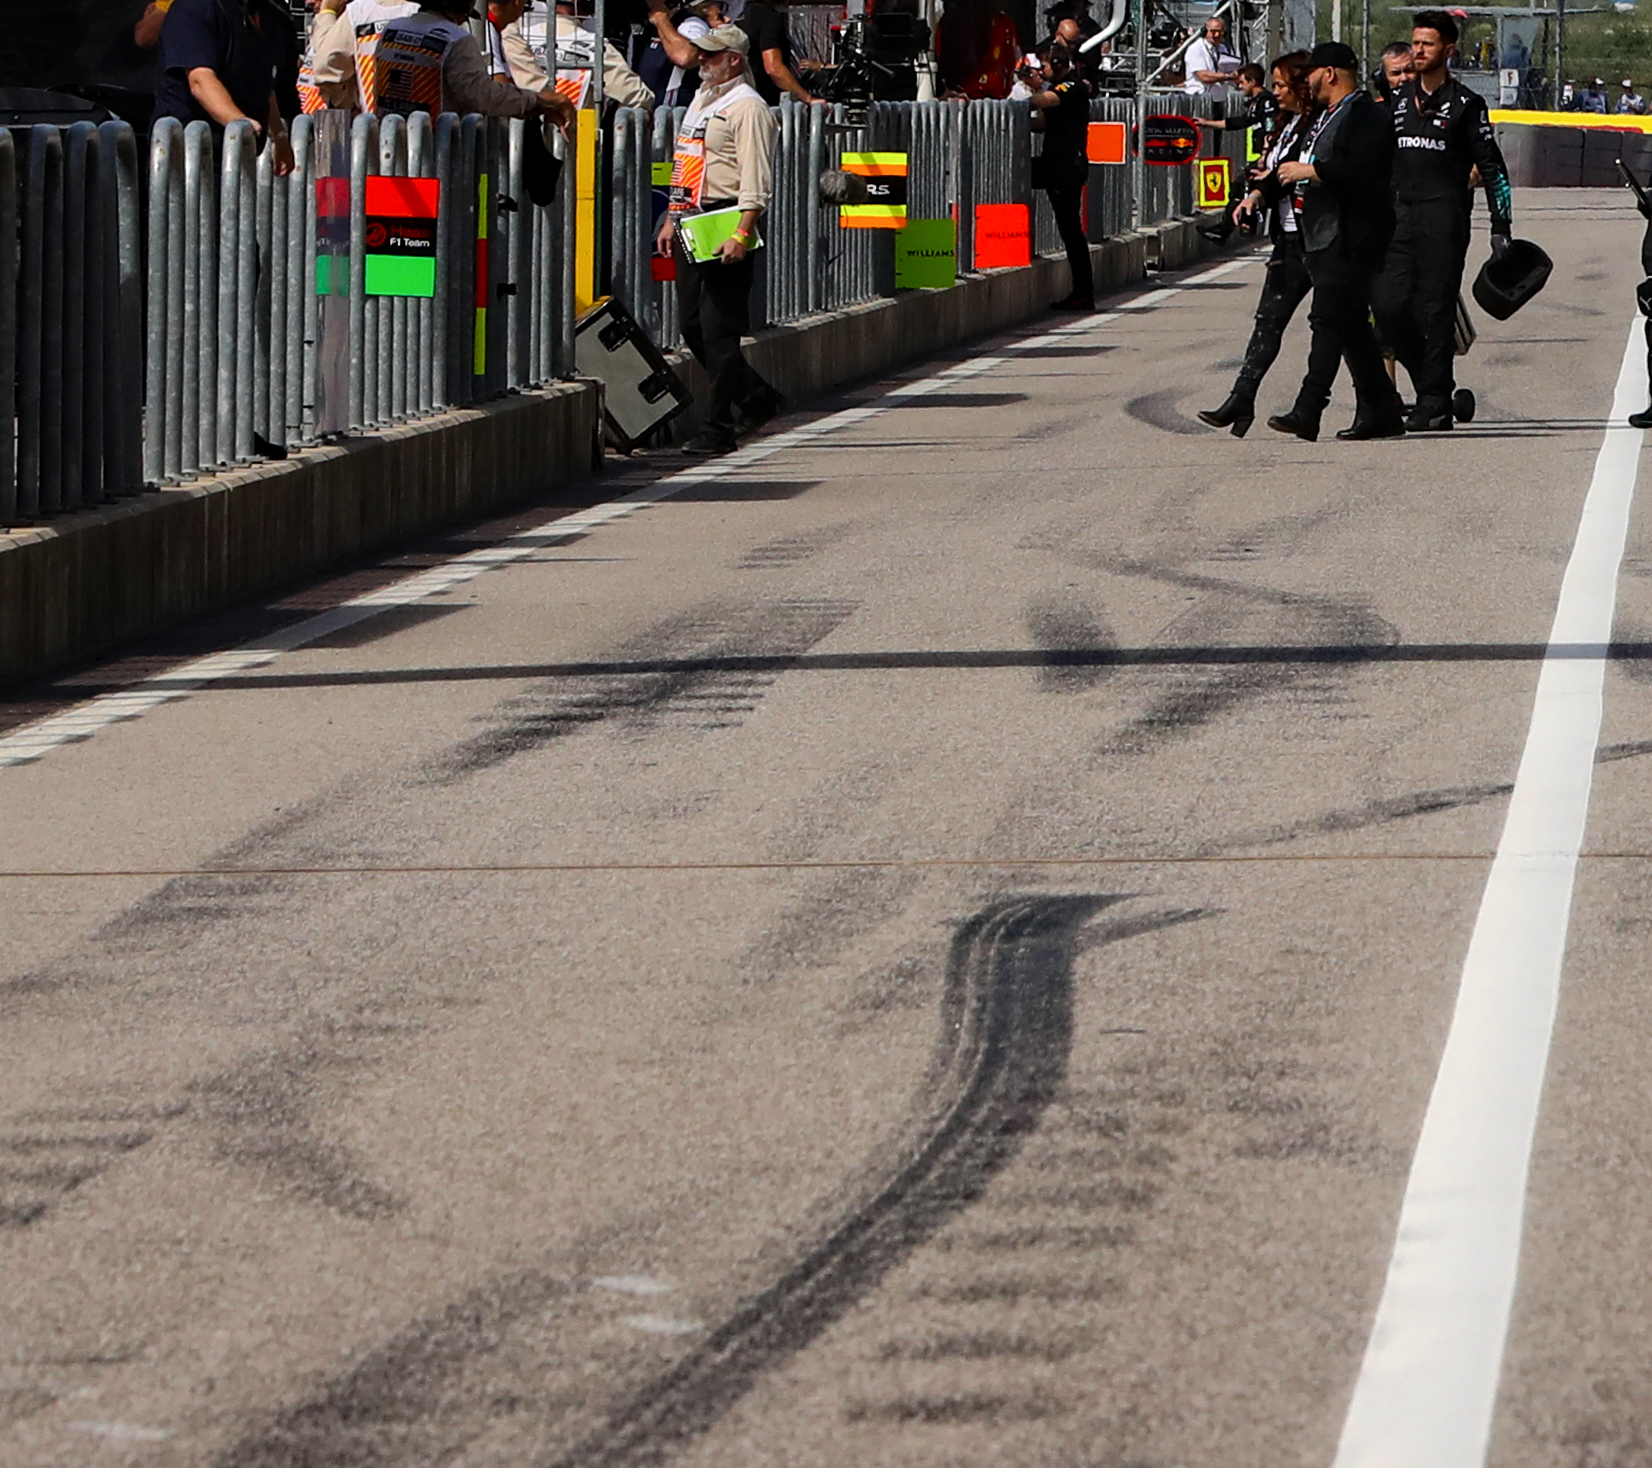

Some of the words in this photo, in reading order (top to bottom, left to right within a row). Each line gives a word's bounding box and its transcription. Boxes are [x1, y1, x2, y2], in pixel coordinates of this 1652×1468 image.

[389, 237, 402, 247] F1
[404, 237, 431, 247] Team
[907, 249, 955, 258] WILLIAMS
